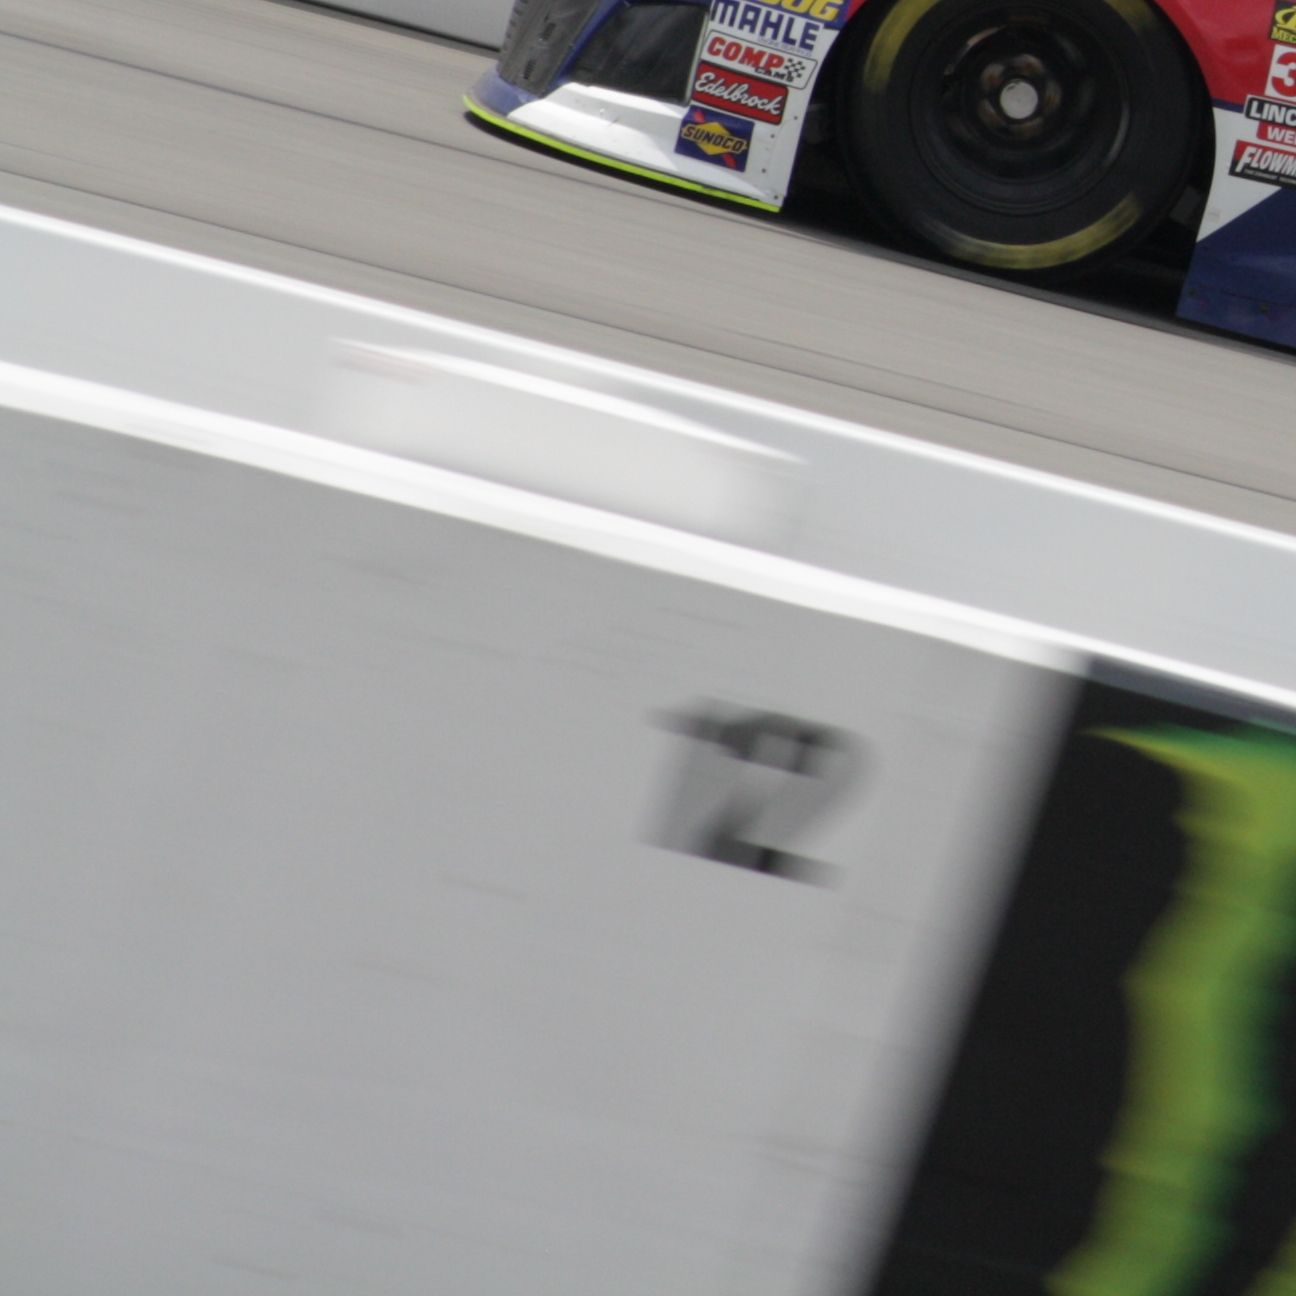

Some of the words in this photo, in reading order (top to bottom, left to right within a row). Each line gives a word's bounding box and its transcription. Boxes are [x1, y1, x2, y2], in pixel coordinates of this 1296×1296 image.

[707, 37, 785, 70] COMP
[695, 72, 783, 115] Edelbrock
[683, 125, 745, 153] SUNOCO
